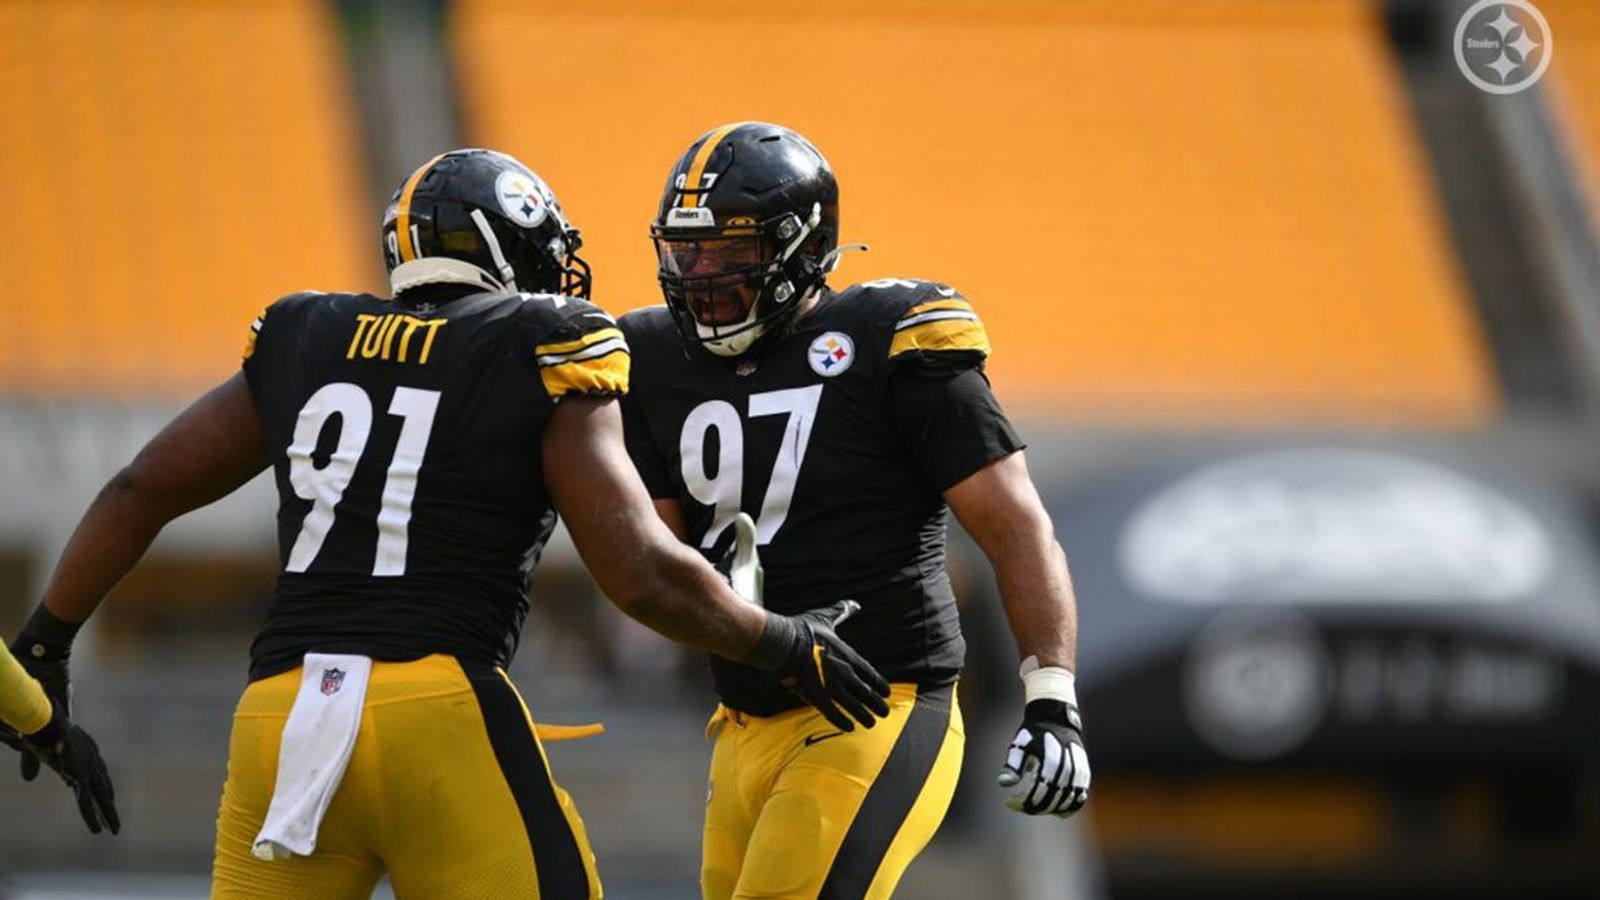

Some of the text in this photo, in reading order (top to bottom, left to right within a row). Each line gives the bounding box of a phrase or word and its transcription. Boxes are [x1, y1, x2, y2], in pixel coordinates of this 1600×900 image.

[672, 173, 718, 207] 97
[346, 313, 448, 365] TUITT
[285, 382, 442, 576] 91
[680, 383, 824, 549] 97
